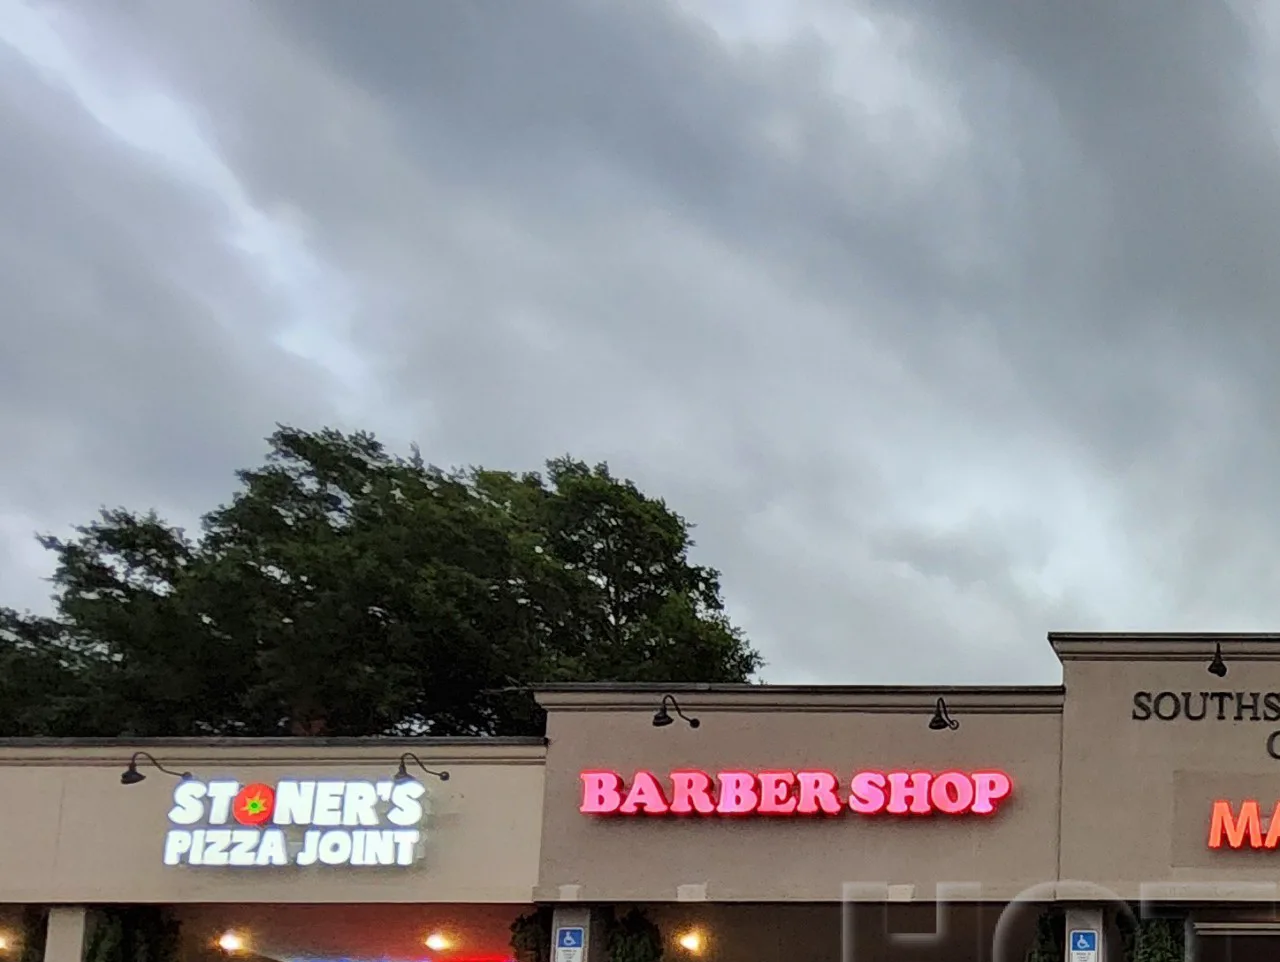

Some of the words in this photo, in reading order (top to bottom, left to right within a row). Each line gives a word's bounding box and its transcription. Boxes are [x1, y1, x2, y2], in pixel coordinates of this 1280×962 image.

[167, 781, 426, 827] STONER'S
[579, 770, 842, 816] BARBER
[847, 770, 1013, 815] SHOP
[163, 829, 288, 867] PIZZA
[296, 830, 420, 867] JOINT
